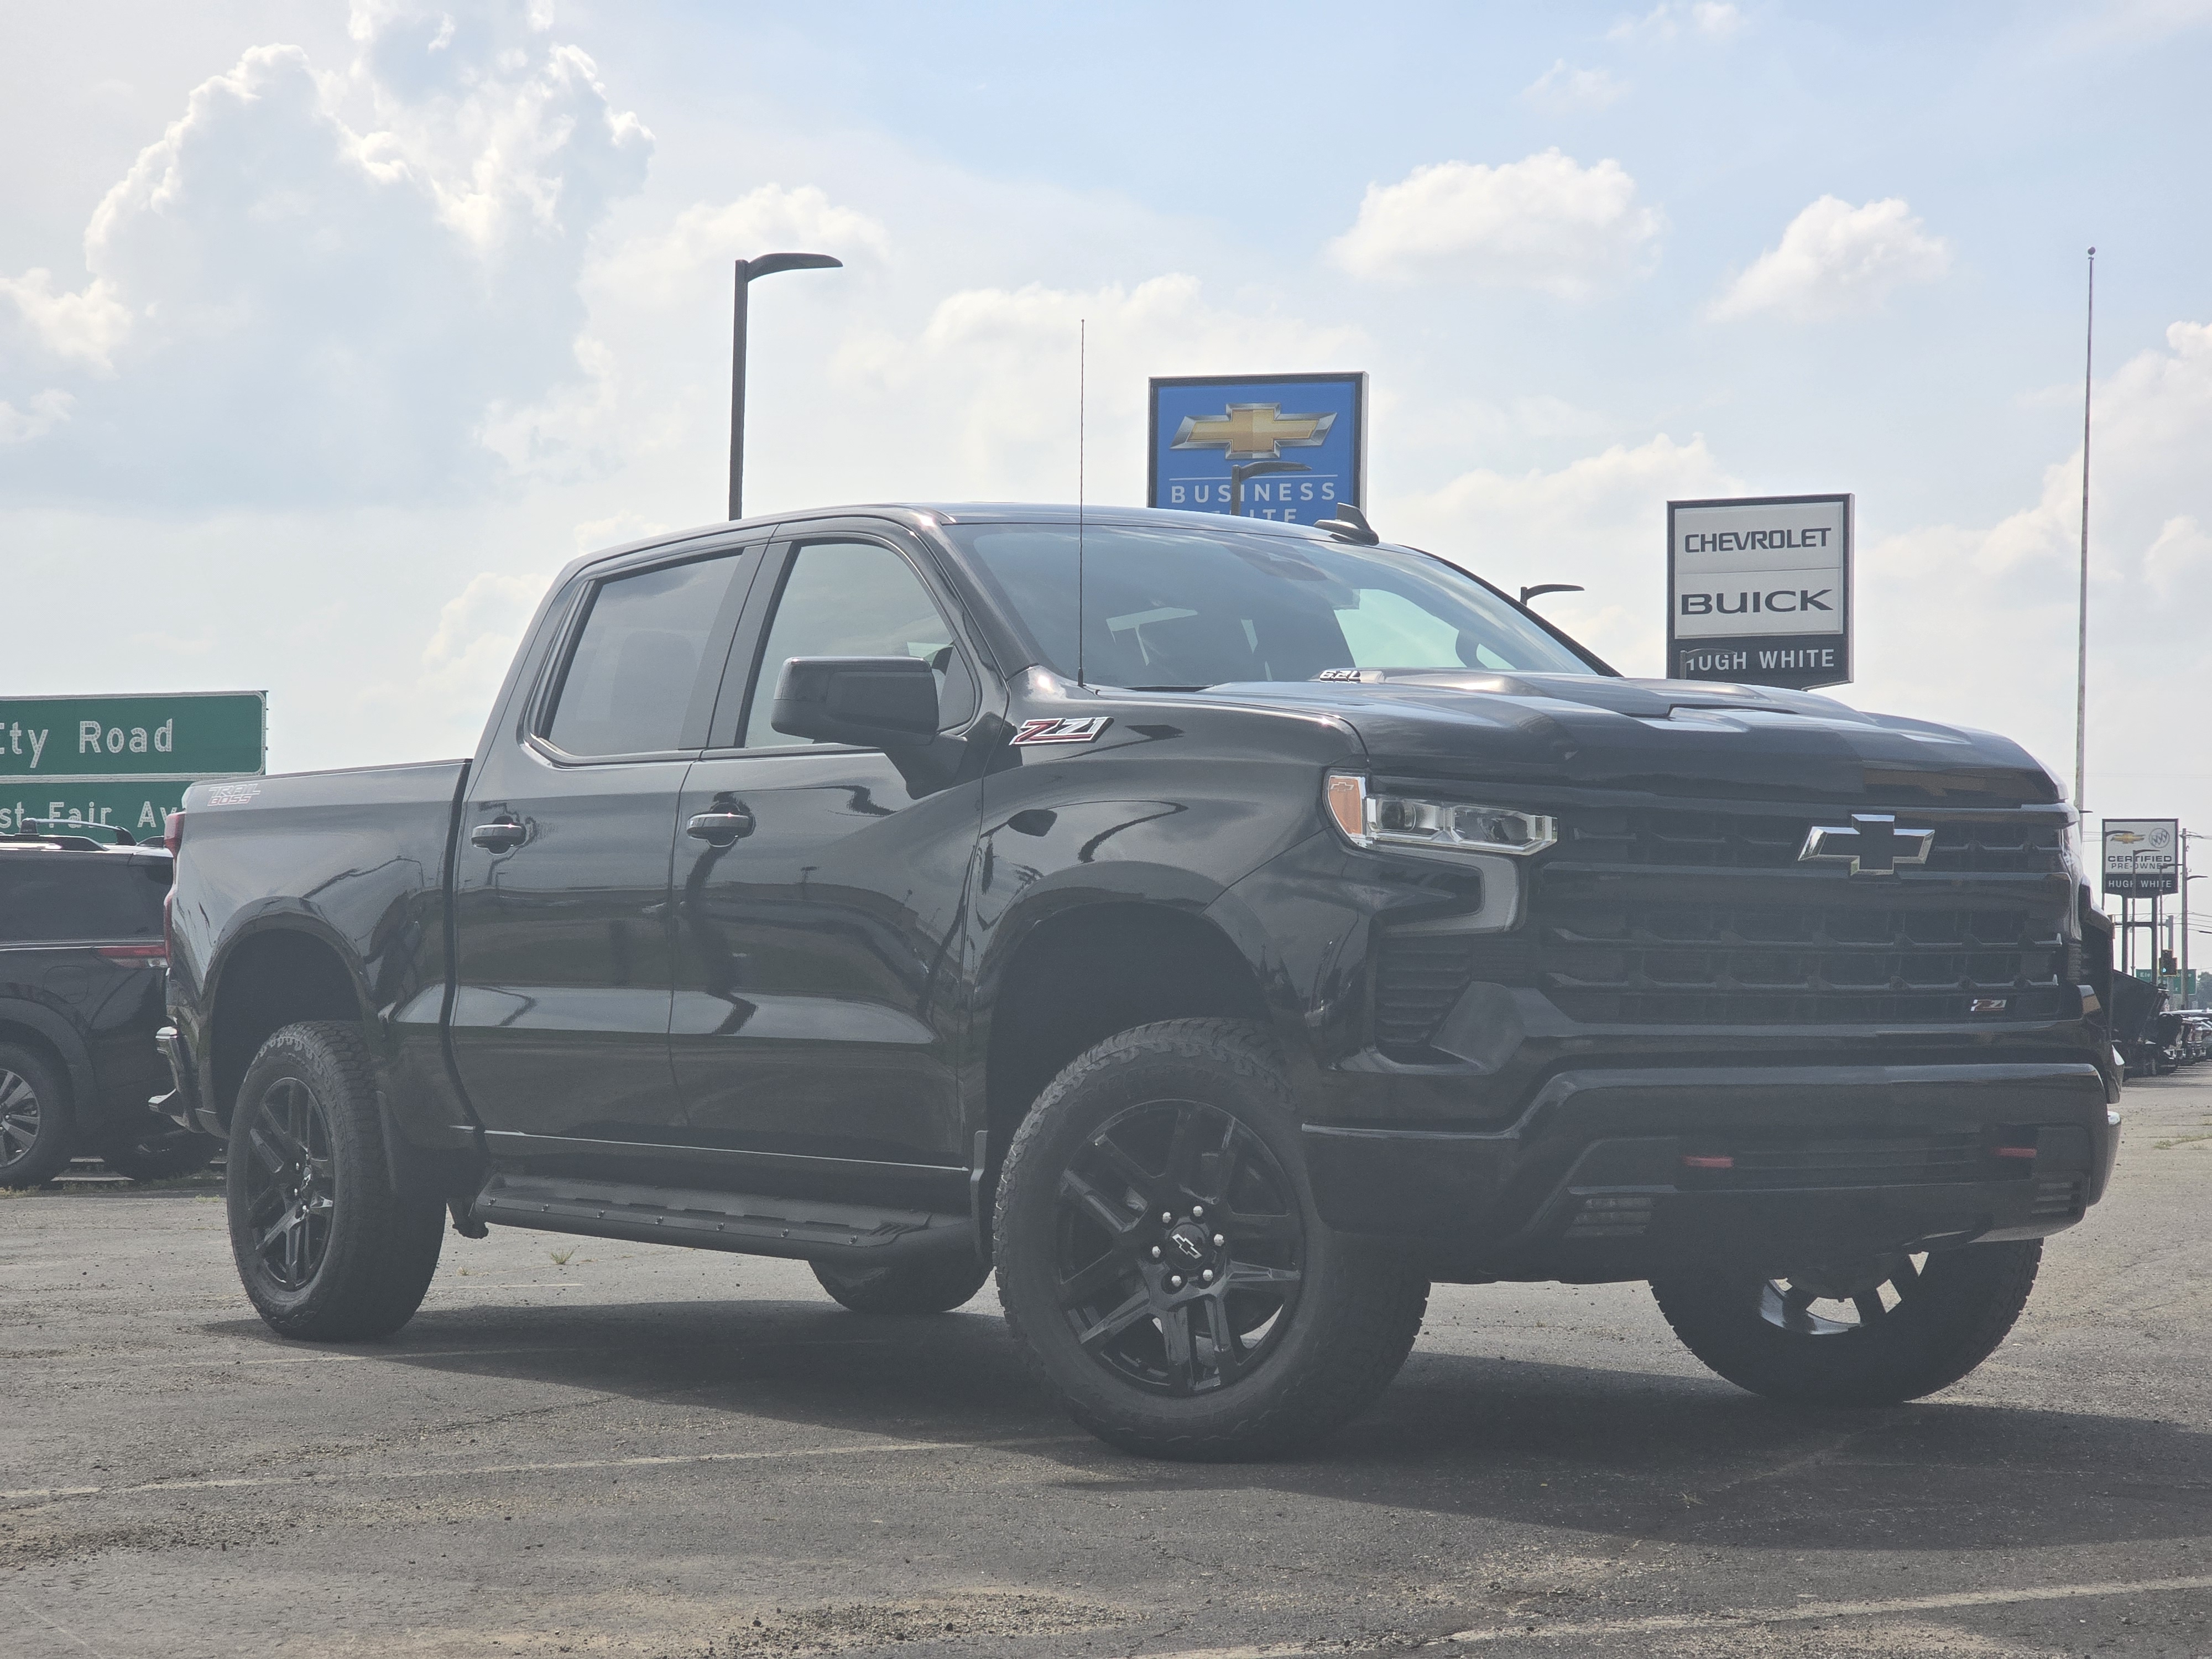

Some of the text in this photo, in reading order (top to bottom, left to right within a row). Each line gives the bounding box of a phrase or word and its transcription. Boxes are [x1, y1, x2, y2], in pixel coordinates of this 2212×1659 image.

[1171, 483, 1335, 503] BUSINESS
[1684, 528, 1832, 553] CHEVROLET
[1682, 589, 1834, 615] BUICK
[1759, 649, 1834, 669] WHITE
[1319, 670, 1361, 681] 6.2L
[1009, 717, 1114, 745] Z71
[0, 718, 173, 768] ty Road
[207, 795, 252, 806] BOSS
[208, 783, 261, 796] TRAIL
[49, 801, 112, 828] Fair
